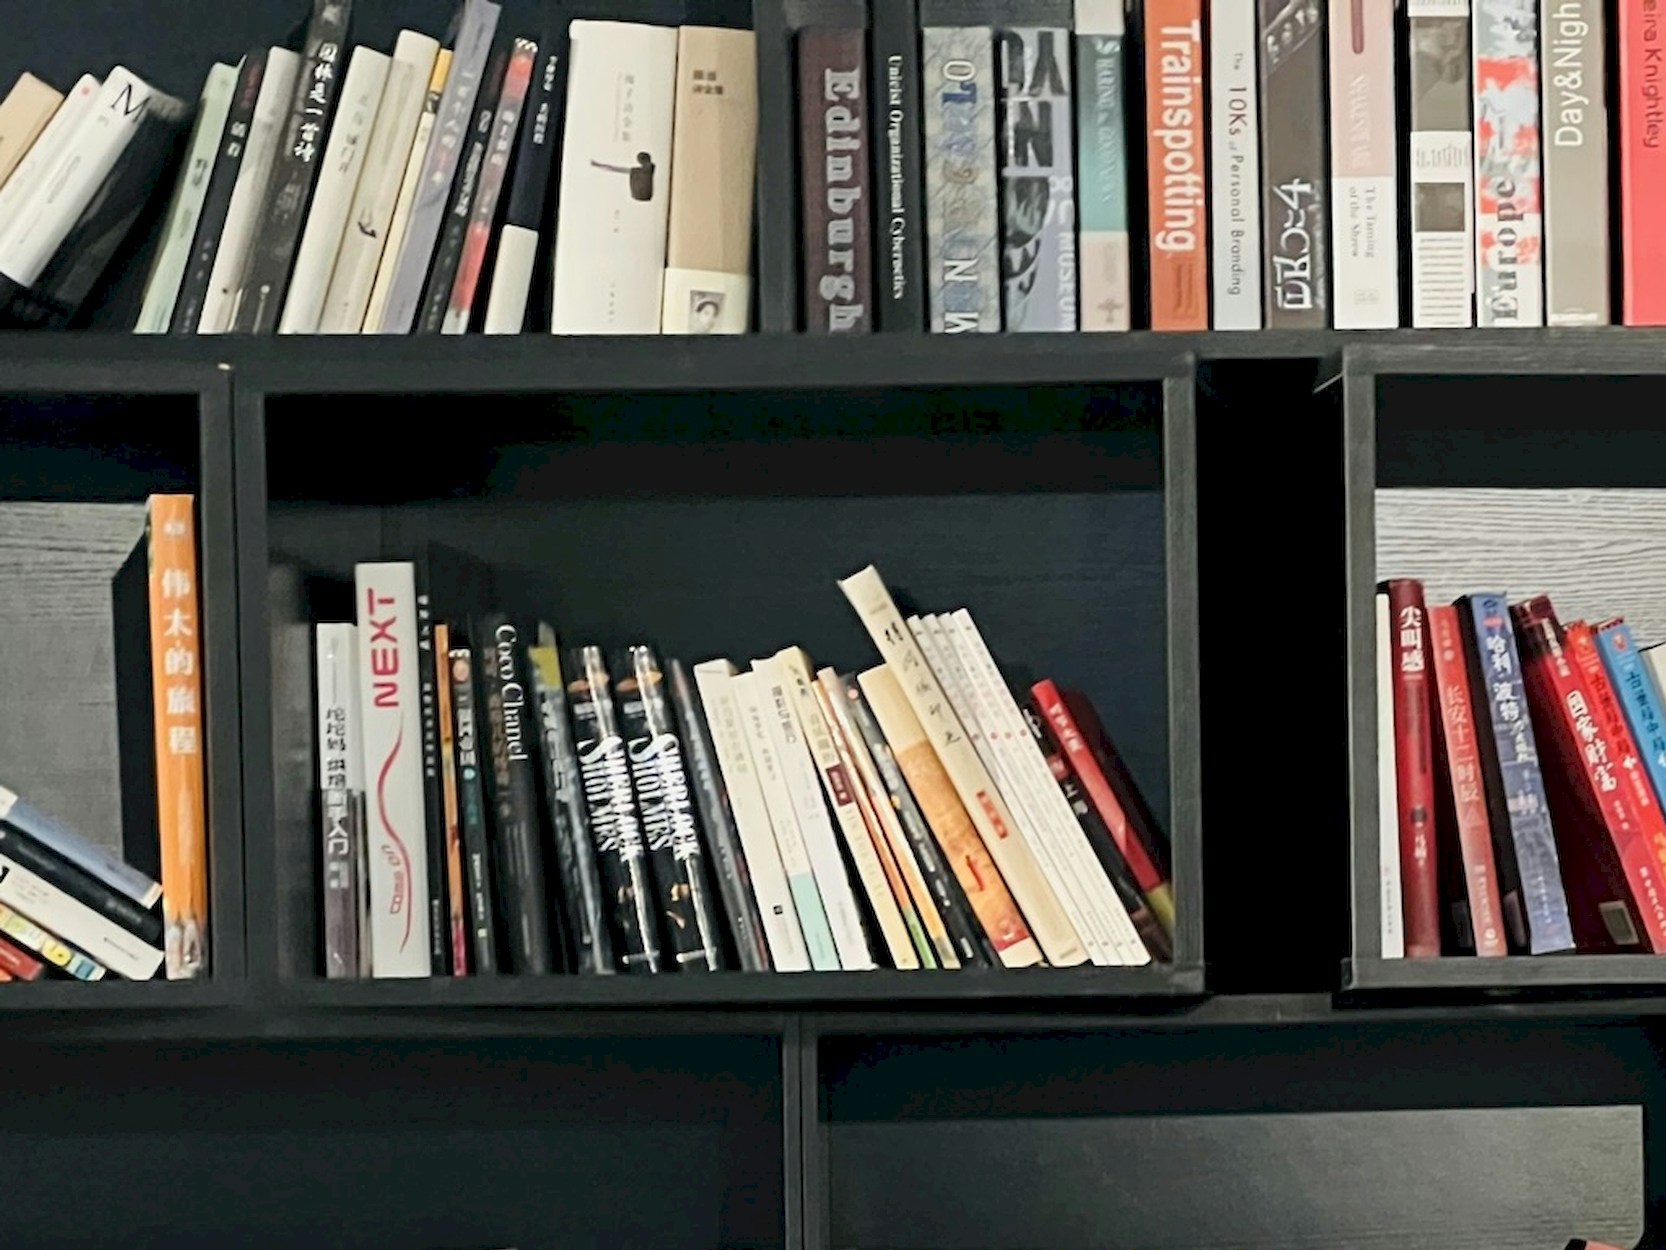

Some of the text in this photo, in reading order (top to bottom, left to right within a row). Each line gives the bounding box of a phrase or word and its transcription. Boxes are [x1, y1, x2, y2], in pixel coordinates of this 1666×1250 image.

[1228, 86, 1248, 136] 10Ks
[1233, 52, 1243, 71] The
[1641, 48, 1665, 149] Knightley
[887, 109, 905, 213] Organizational
[1153, 19, 1205, 253] Trainspotting
[819, 68, 864, 333] Edinburgh
[1229, 155, 1246, 223] Personal
[889, 217, 907, 300] Cybernetics
[1227, 230, 1246, 296] Branding
[1490, 179, 1524, 321] Europe
[367, 587, 400, 709] NEXT
[1400, 605, 1425, 672] 尖叫感
[495, 623, 529, 762] Coco Chanel
[1446, 685, 1480, 803] 长安十二时辰
